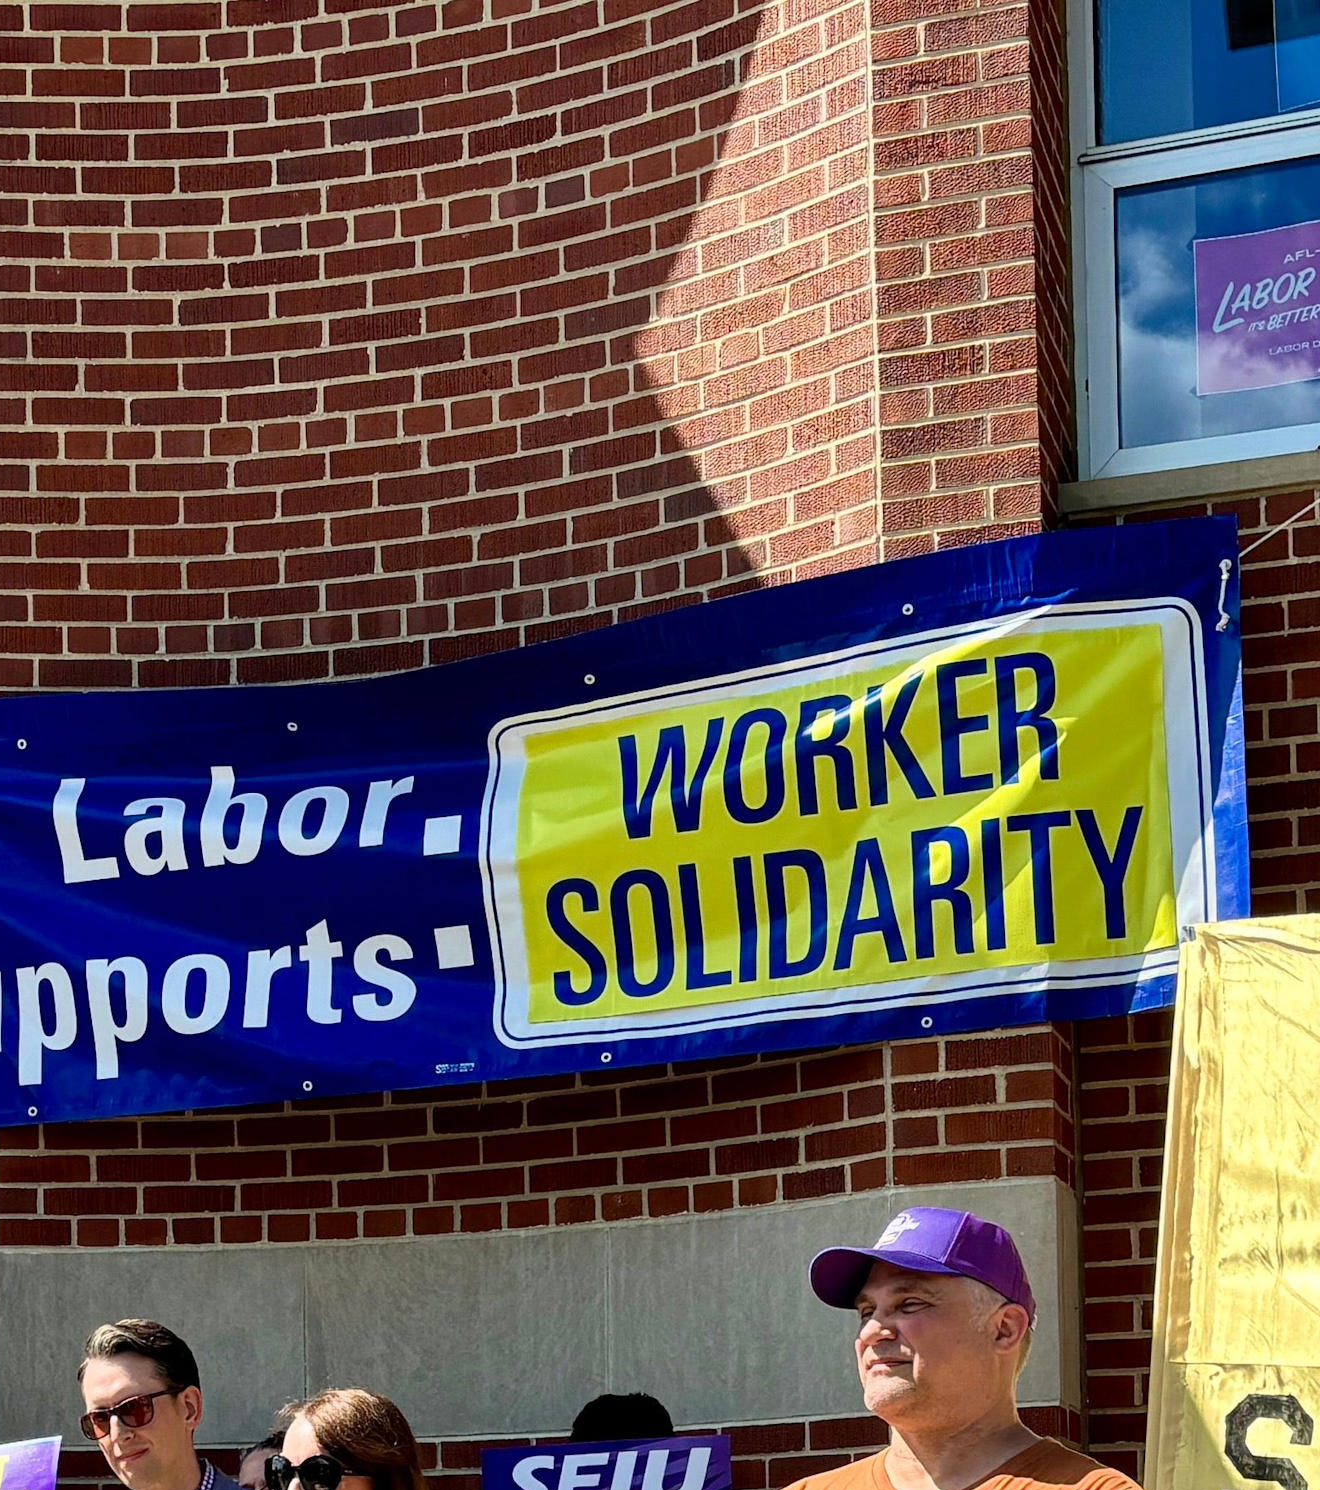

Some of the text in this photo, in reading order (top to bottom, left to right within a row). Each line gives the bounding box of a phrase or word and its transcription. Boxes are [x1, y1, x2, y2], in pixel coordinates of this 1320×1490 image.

[1212, 267, 1316, 334] LABOR
[1267, 304, 1320, 331] BETTER
[1268, 341, 1310, 355] LABOR
[618, 652, 1060, 839] WORKER
[53, 765, 414, 883] Labor
[545, 806, 1143, 1006] SOLIDARITY
